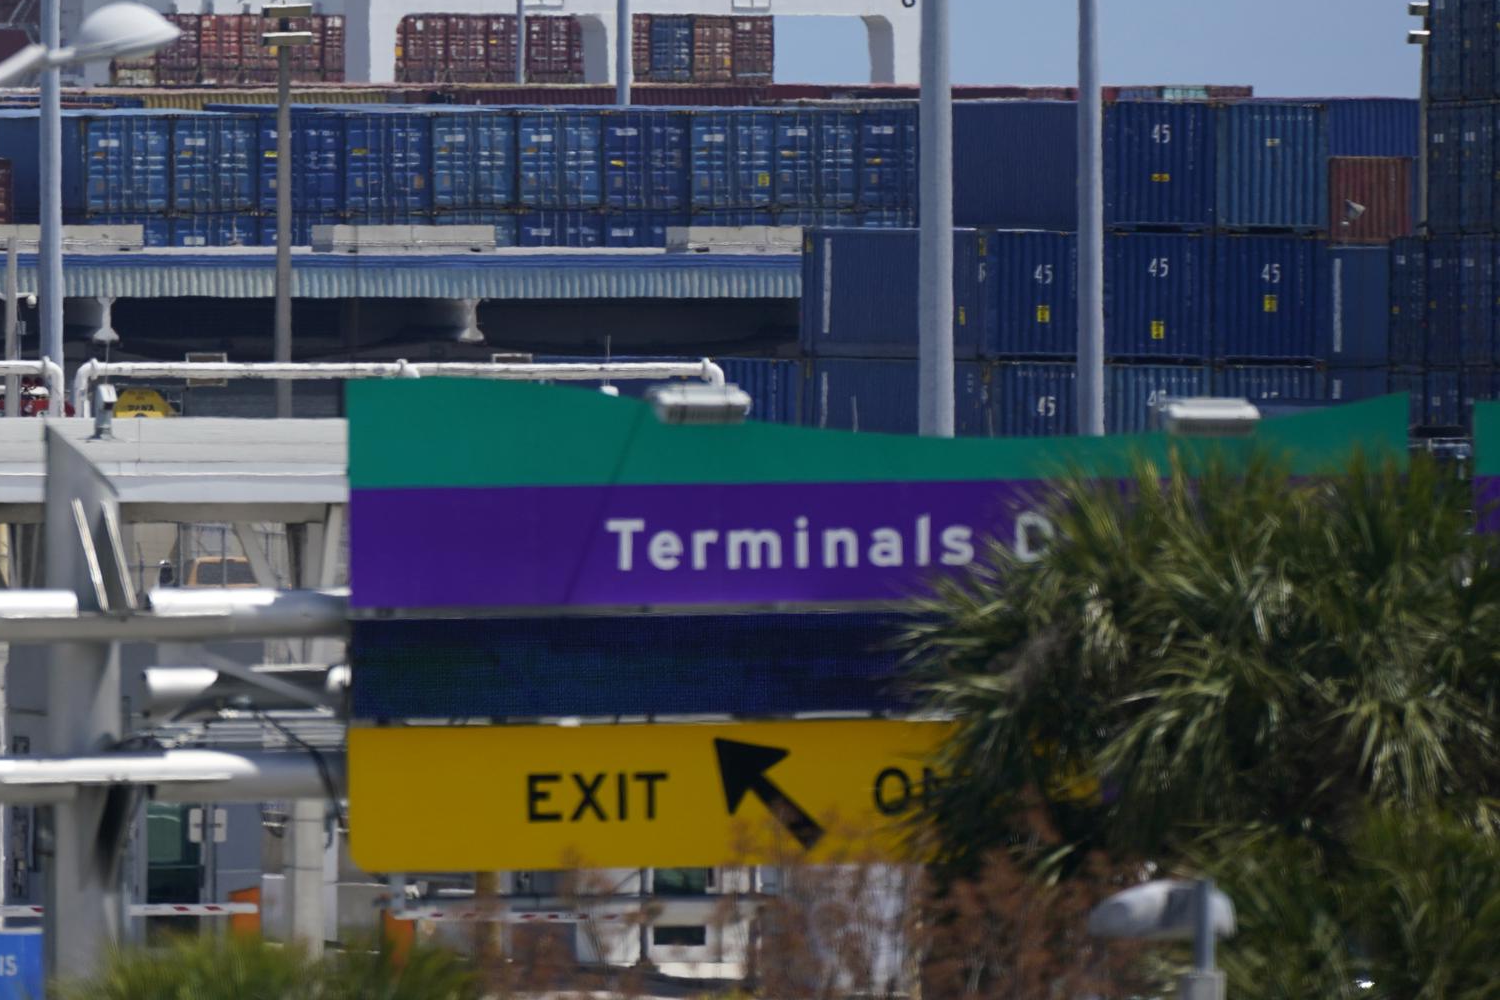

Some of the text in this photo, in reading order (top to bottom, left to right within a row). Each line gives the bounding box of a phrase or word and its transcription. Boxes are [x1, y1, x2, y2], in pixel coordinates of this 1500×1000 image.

[1151, 124, 1171, 144] 45
[1033, 263, 1054, 284] 45
[1148, 257, 1170, 278] 45
[1260, 263, 1282, 284] 45
[1036, 395, 1057, 417] 45
[605, 515, 975, 571] Terminals
[526, 772, 669, 823] EXIT
